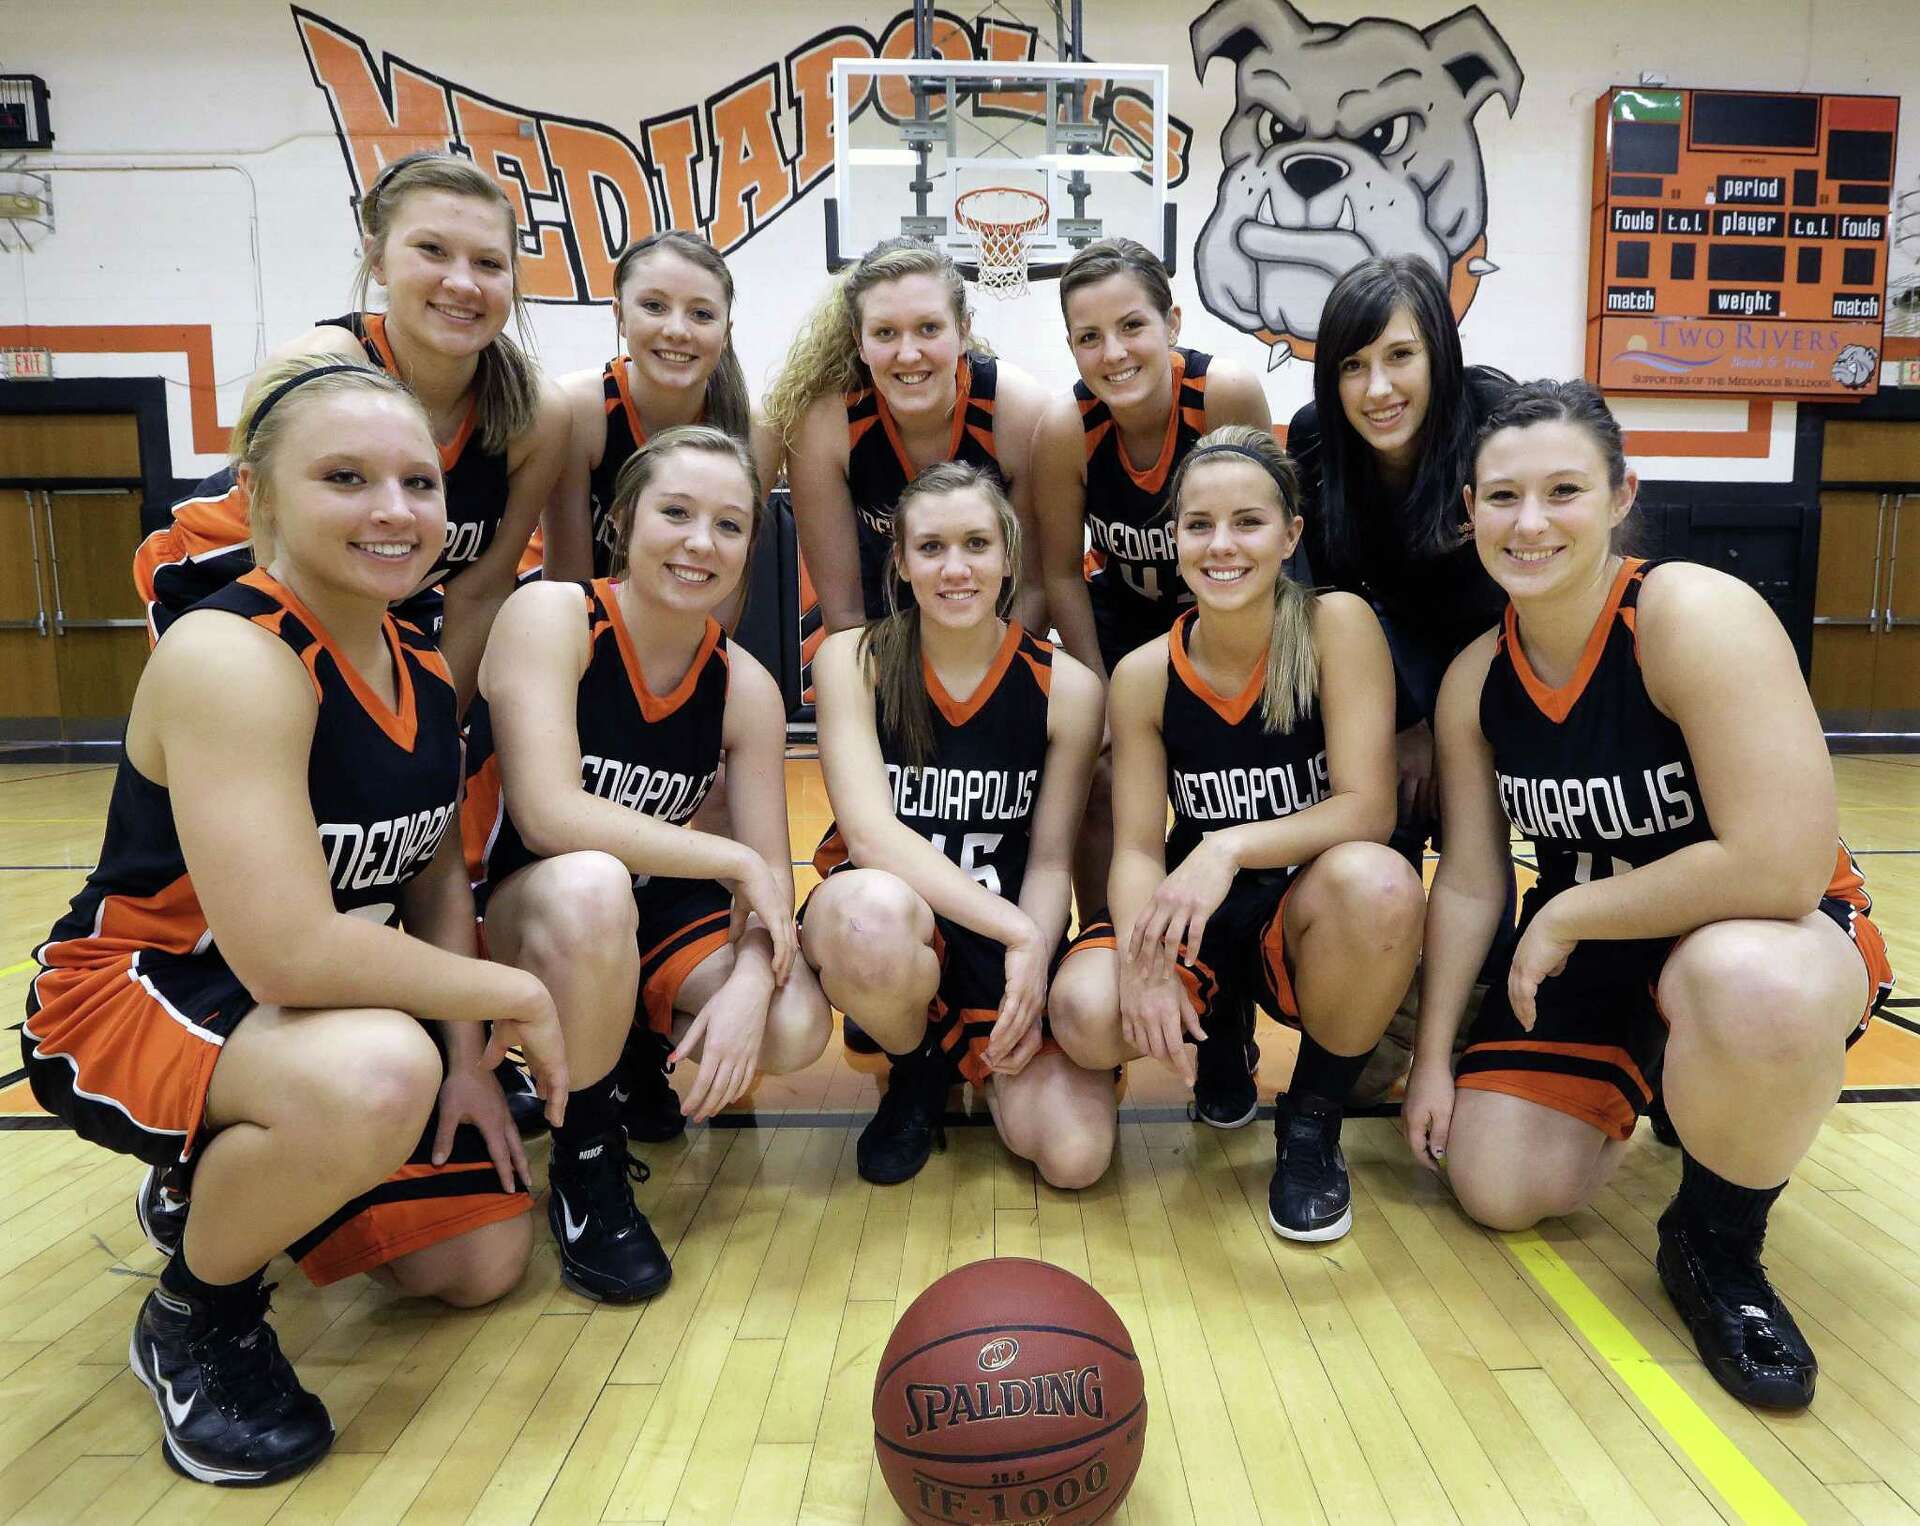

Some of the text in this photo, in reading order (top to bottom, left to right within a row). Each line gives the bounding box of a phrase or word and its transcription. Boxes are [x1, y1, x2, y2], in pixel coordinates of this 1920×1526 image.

[1724, 178, 1778, 200] period
[1614, 209, 1654, 230] fouls
[1722, 211, 1776, 233] player
[1842, 217, 1880, 237] fouls
[1608, 289, 1654, 310] match
[1718, 291, 1772, 313] weight
[1833, 296, 1878, 317] match
[1653, 320, 1840, 351] TWO RIVERS
[15, 352, 42, 376] EXIT
[581, 755, 717, 822] EDIAPOLIS
[1496, 761, 1695, 839] EDIAPOLIS
[931, 833, 1004, 895] 5
[905, 1366, 1106, 1437] SPALDING
[912, 1461, 1110, 1523] TF-1000
